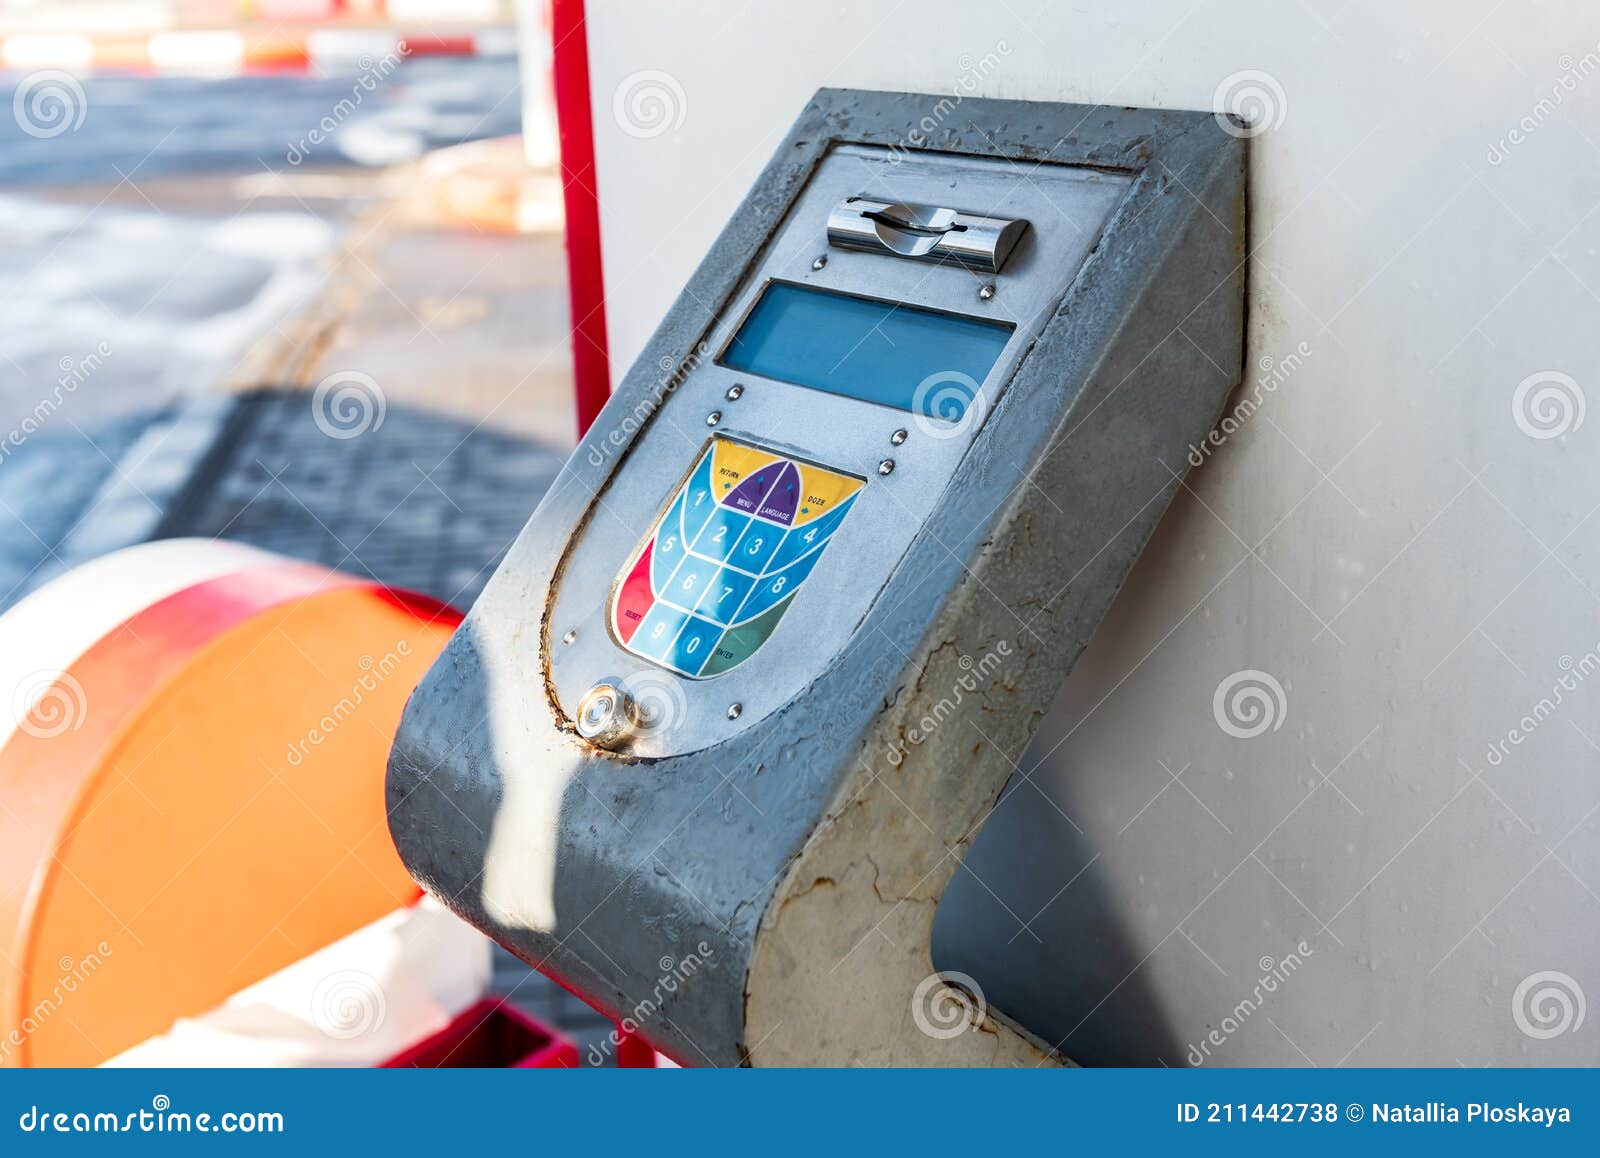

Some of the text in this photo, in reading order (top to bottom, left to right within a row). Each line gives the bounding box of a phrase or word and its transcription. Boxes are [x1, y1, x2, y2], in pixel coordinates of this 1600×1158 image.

[695, 491, 705, 506] 1
[736, 498, 753, 508] MENU
[761, 506, 790, 521] LANGUAGE
[713, 526, 727, 543] 2
[804, 527, 818, 544] 4
[662, 536, 677, 552] 5
[749, 538, 763, 555] 3
[683, 574, 696, 590] 6
[772, 576, 786, 593] 8
[718, 587, 733, 604] 7
[651, 622, 666, 639] 9
[686, 637, 700, 654] 0
[716, 648, 734, 660] ENTER
